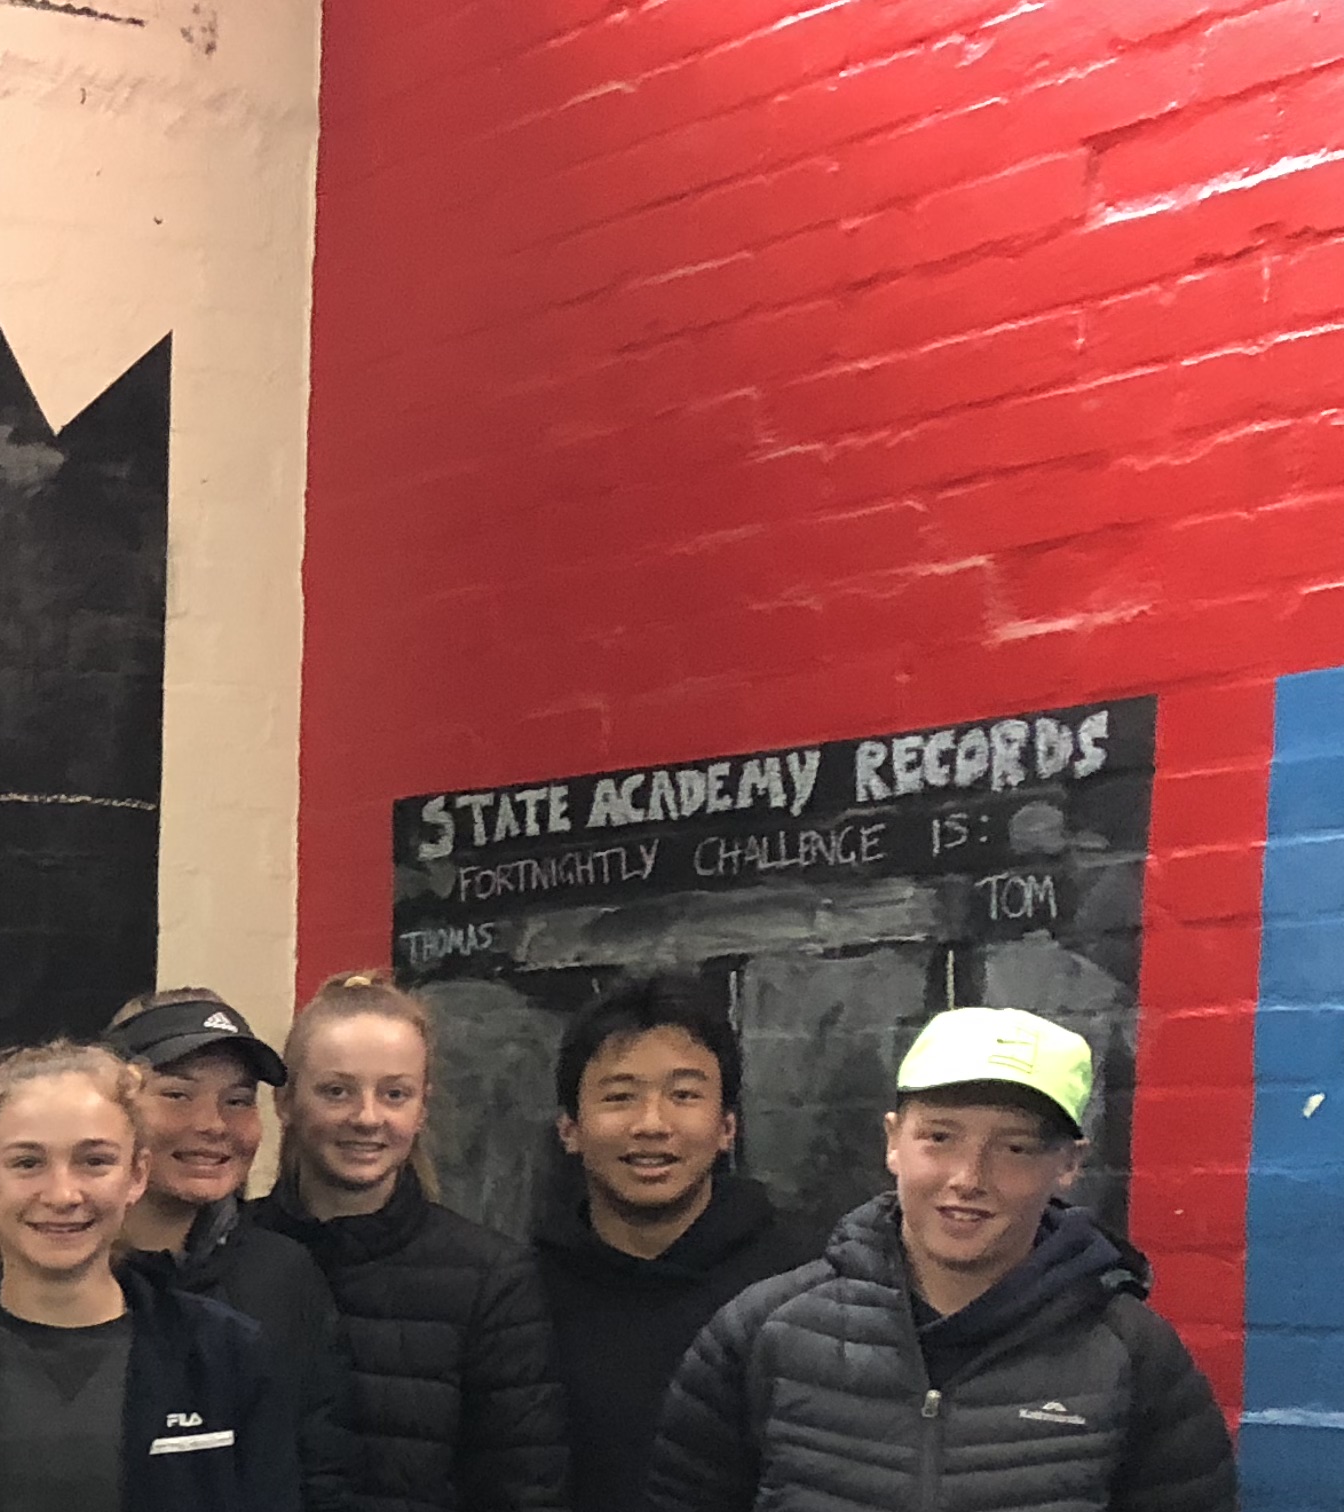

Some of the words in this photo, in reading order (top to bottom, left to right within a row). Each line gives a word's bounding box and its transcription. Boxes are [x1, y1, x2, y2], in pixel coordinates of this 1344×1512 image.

[419, 794, 572, 862] STATE
[586, 748, 822, 829] ACADEMY
[853, 709, 1112, 803] RECORDS
[694, 822, 887, 876] CHALLENGE
[976, 872, 1059, 921] TOM
[399, 921, 496, 964] THOMAS
